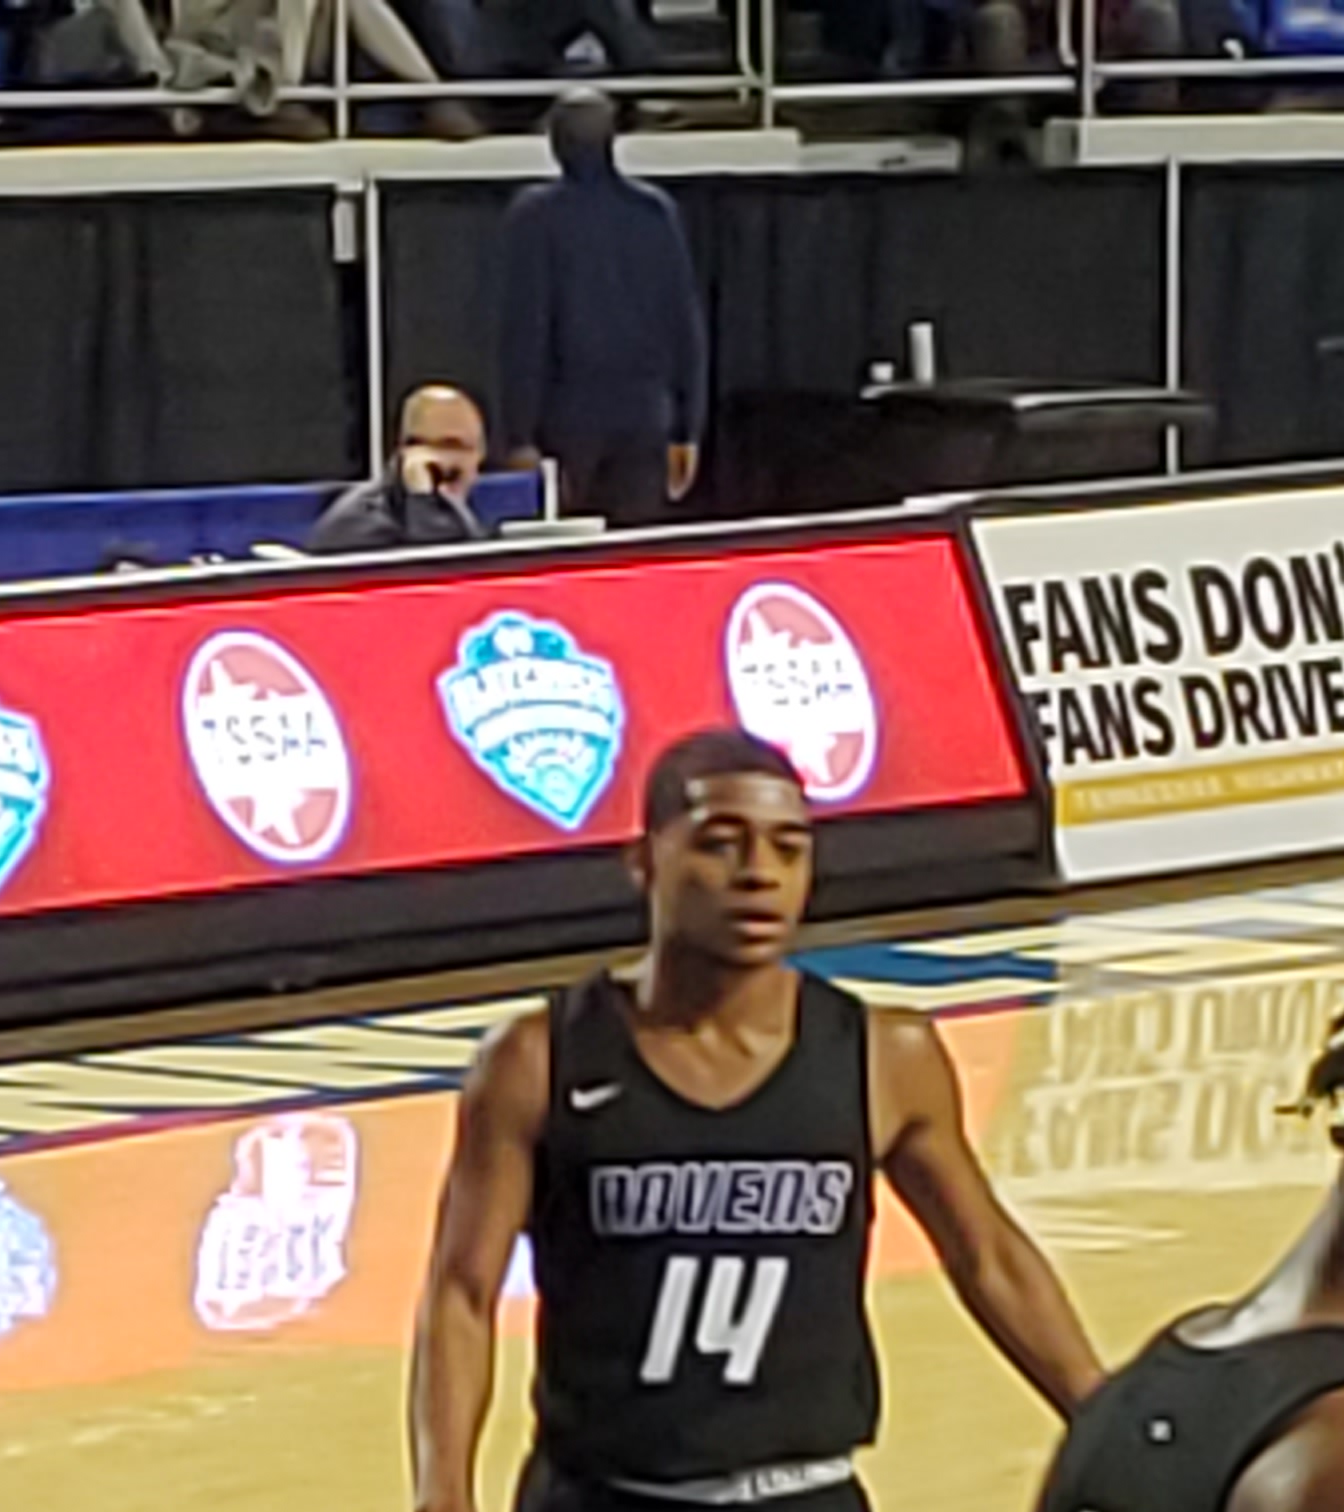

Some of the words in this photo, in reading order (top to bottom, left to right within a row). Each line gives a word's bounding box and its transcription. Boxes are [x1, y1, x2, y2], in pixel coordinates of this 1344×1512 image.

[1001, 569, 1183, 677] FANS
[1028, 680, 1175, 766] FANS
[590, 1160, 854, 1237] RAVENS
[639, 1255, 790, 1385] 14
